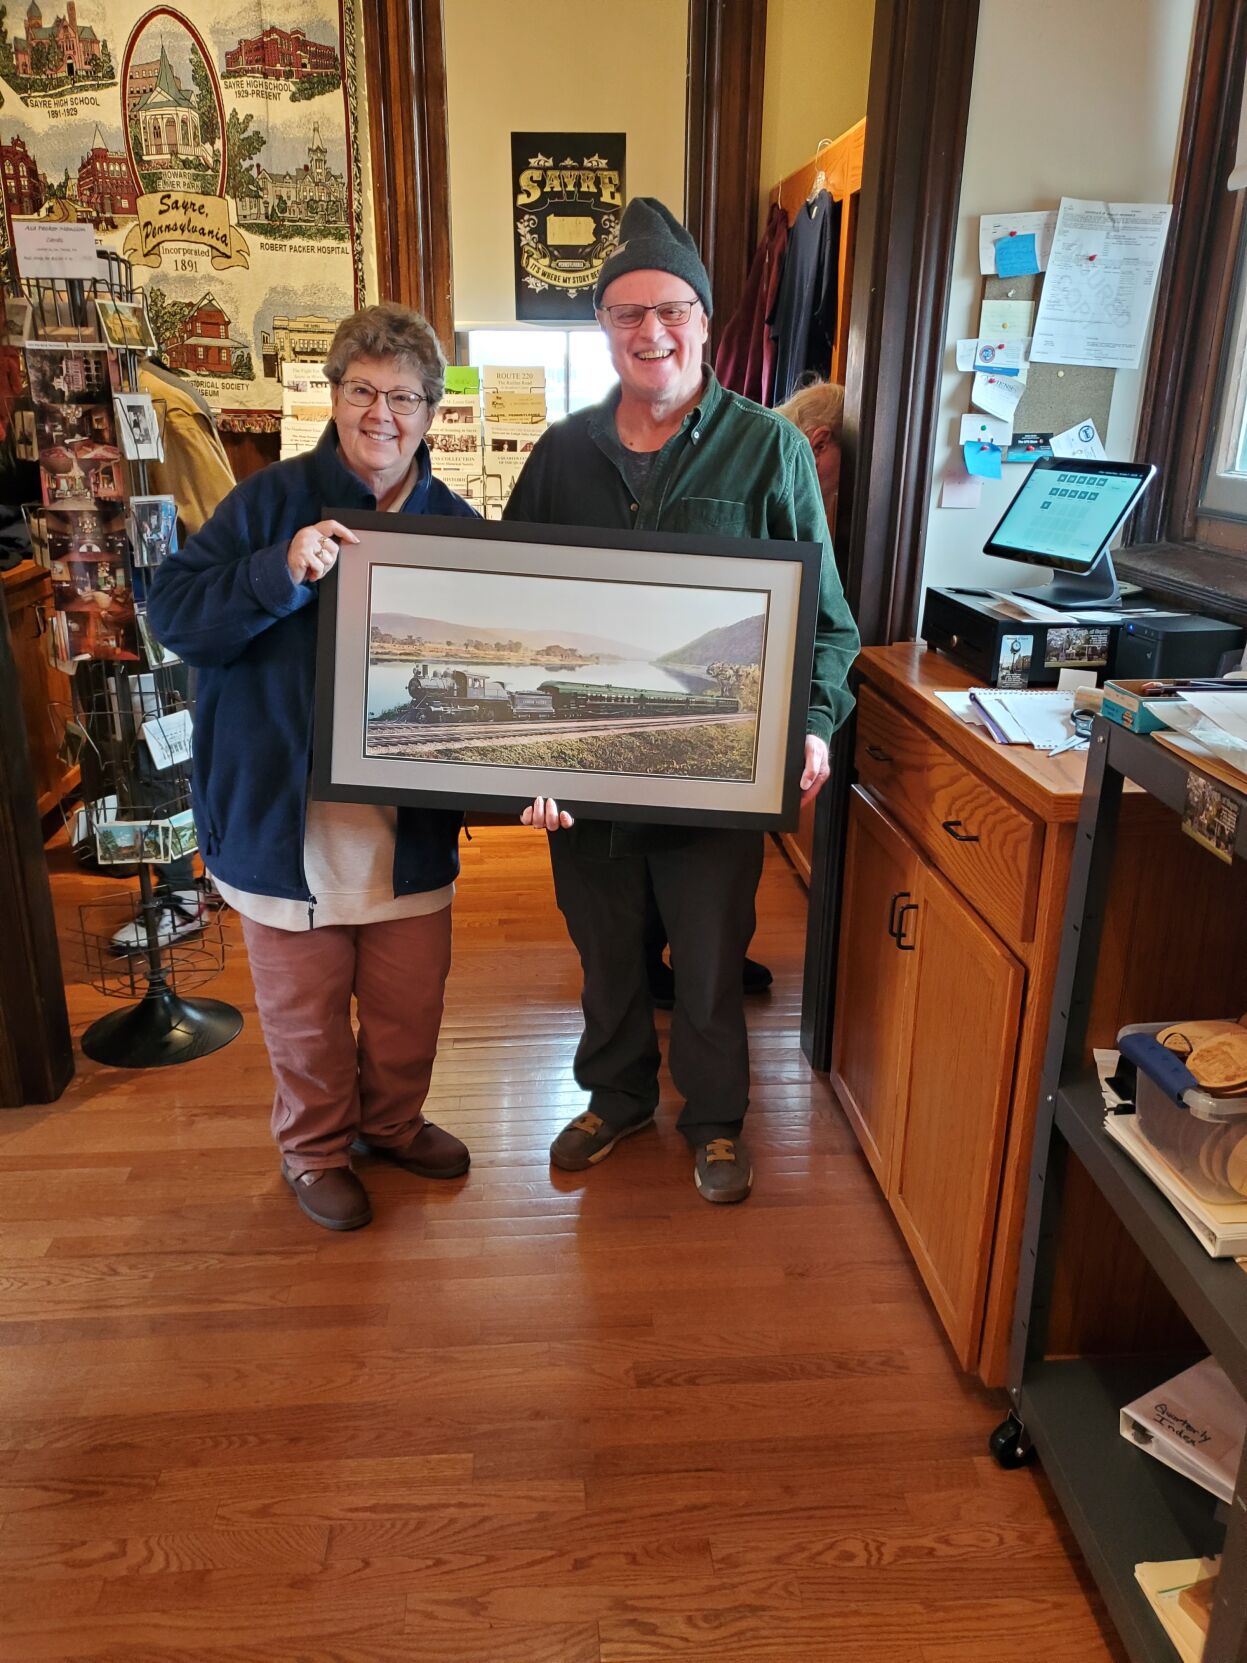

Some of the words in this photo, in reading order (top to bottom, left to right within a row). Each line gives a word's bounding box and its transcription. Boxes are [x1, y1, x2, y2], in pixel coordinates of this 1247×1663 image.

[223, 80, 245, 90] SAYRE
[246, 80, 264, 89] HIGH
[264, 81, 293, 92] SCHOOL
[29, 99, 52, 108] SAYRE
[53, 99, 68, 108] HIGH
[69, 96, 100, 106] SCHOOL
[47, 107, 78, 118] 1891-1929
[162, 170, 192, 180] HOWARD
[516, 168, 622, 206] SAYRE
[158, 193, 209, 218] Sayre,
[142, 217, 229, 248] Pennsylvania
[161, 246, 210, 257] Incorporated
[260, 242, 287, 252] ROBERT
[289, 244, 315, 253] PACKER
[316, 246, 350, 255] HOSPITAL
[174, 259, 198, 273] 1891
[530, 263, 540, 274] IT'S
[540, 269, 561, 283] WHERE
[573, 275, 590, 283] STORY
[496, 372, 520, 380] ROUTE
[221, 382, 250, 391] SOCIETY
[1153, 1413, 1196, 1446] Index
[1154, 1403, 1211, 1443] Quarterly
